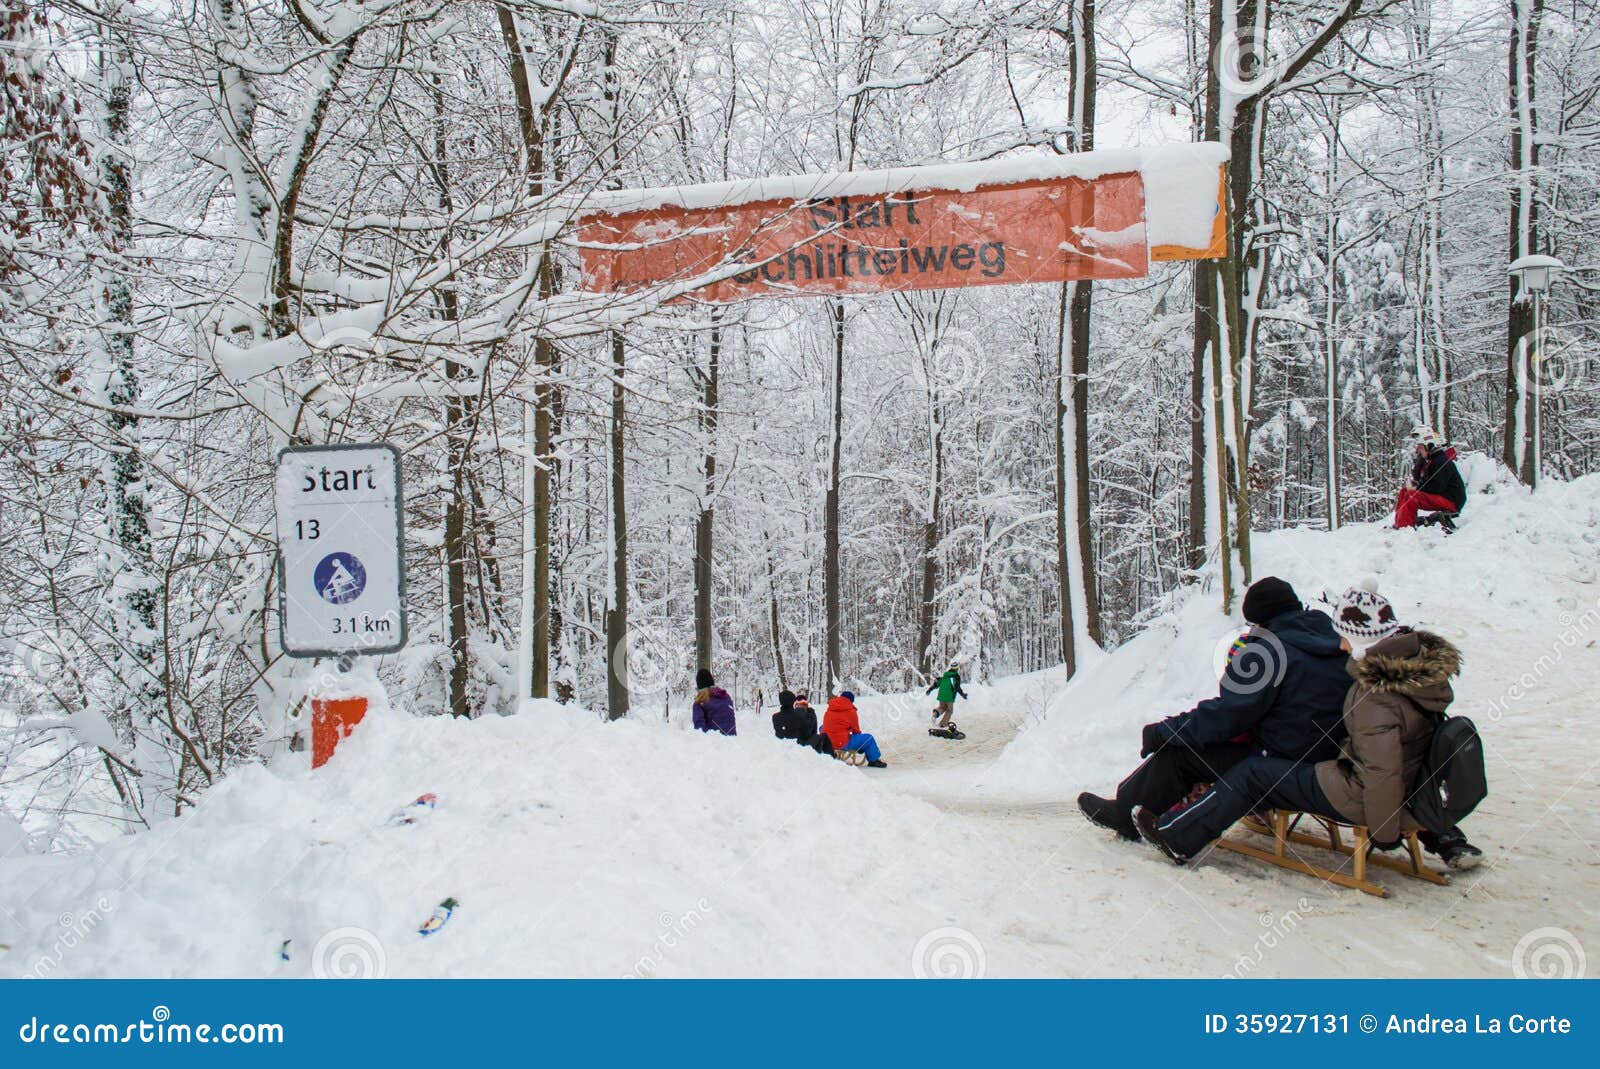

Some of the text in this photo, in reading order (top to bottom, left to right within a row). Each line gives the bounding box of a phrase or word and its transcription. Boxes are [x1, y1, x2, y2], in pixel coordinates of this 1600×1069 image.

[808, 191, 921, 231] Start
[302, 464, 376, 492] Start
[295, 519, 320, 540] 13
[332, 615, 390, 634] 3.1 km
